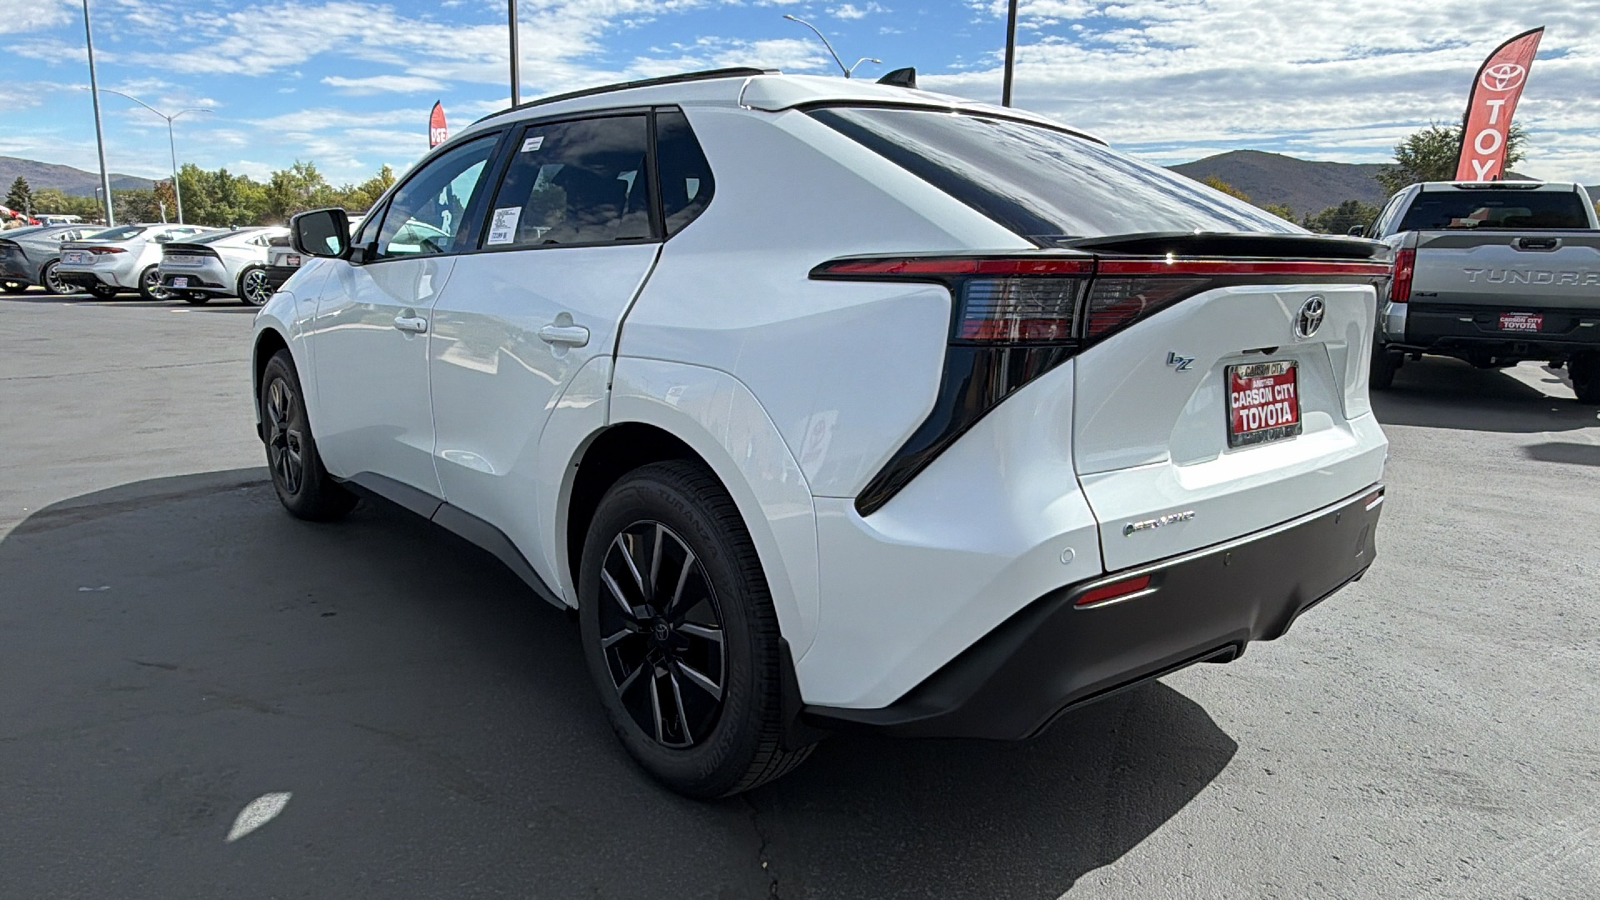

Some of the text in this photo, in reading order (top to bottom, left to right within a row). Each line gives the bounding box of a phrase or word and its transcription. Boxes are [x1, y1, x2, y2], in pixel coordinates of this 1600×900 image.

[431, 127, 448, 144] USE
[1463, 268, 1600, 286] TUNDRA
[1231, 382, 1294, 408] CARSON CITY
[1239, 401, 1292, 431] TOYOTA
